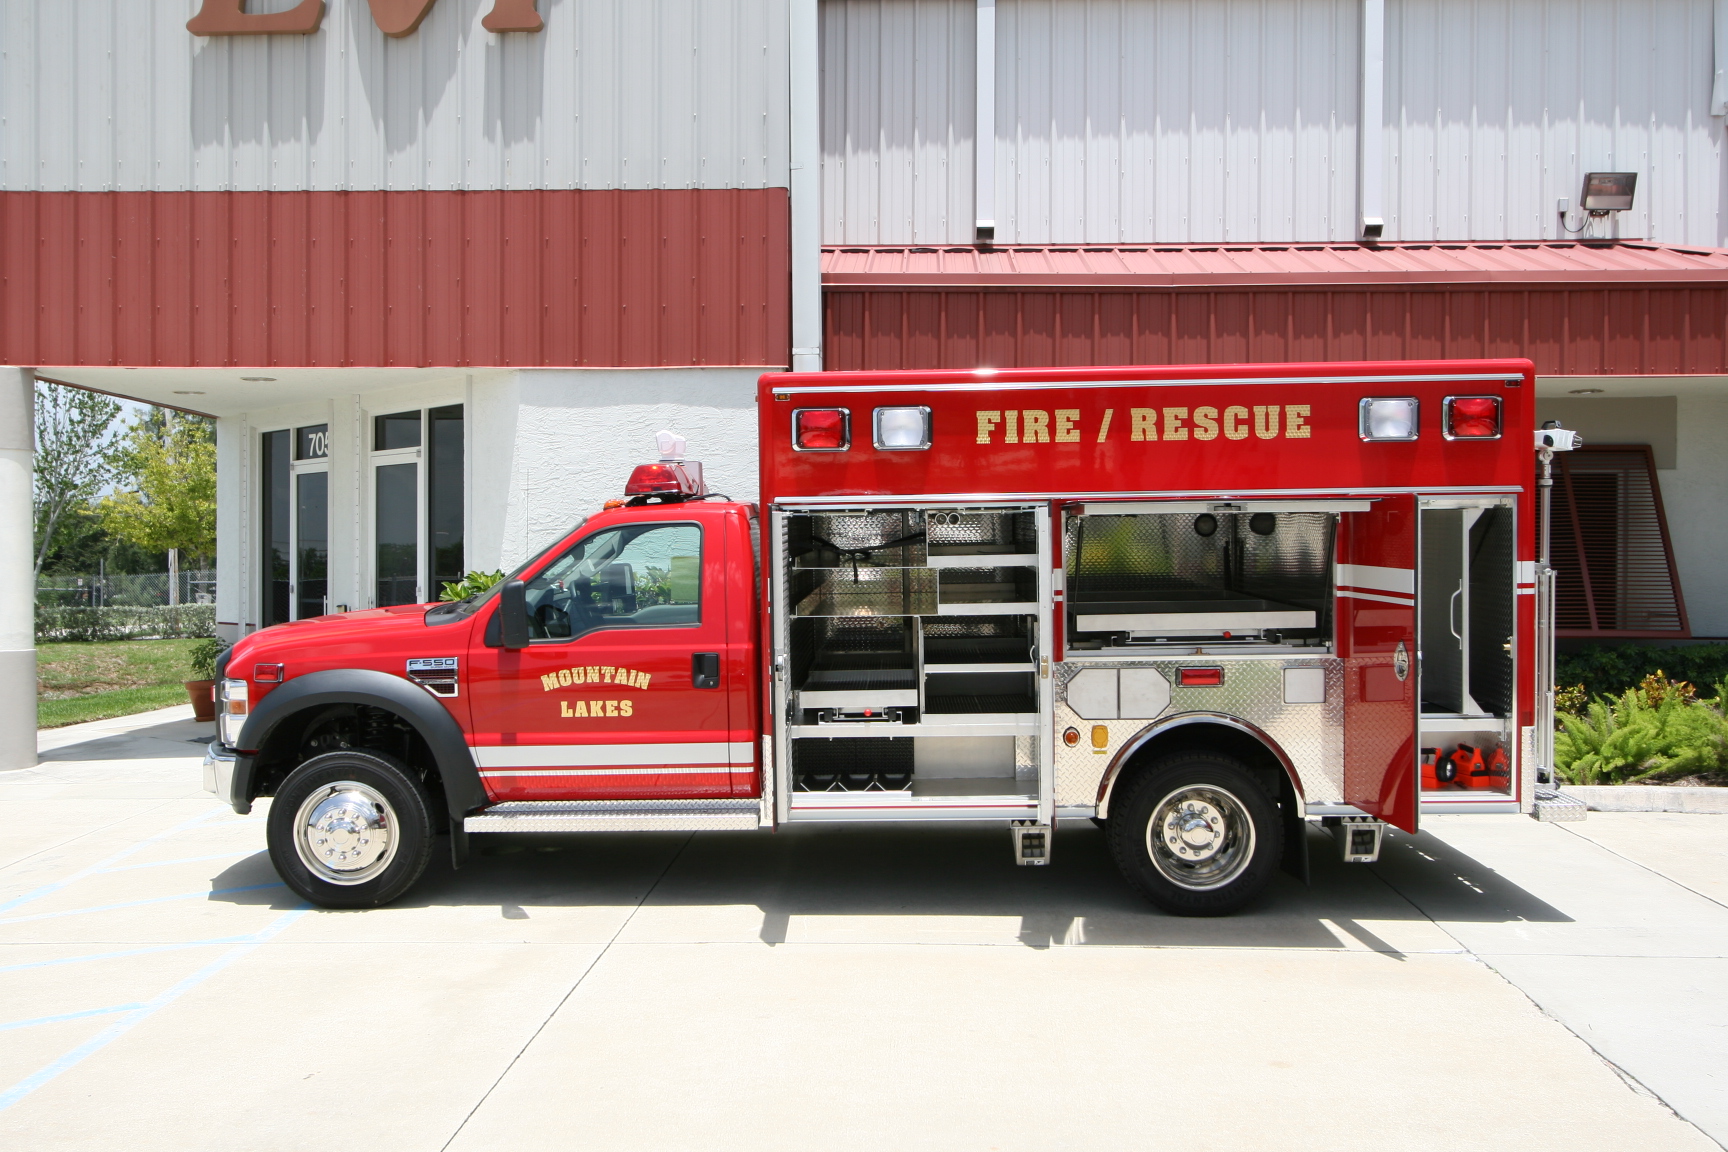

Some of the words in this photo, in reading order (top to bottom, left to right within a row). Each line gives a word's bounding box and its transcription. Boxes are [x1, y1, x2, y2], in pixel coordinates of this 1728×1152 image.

[976, 409, 1080, 444] FIRE
[1097, 408, 1114, 443] /
[1130, 404, 1311, 441] RESCUE
[540, 666, 651, 692] MOUNTAIN
[560, 700, 633, 717] LAKES
[1170, 871, 1257, 904] CONTINENTAL
